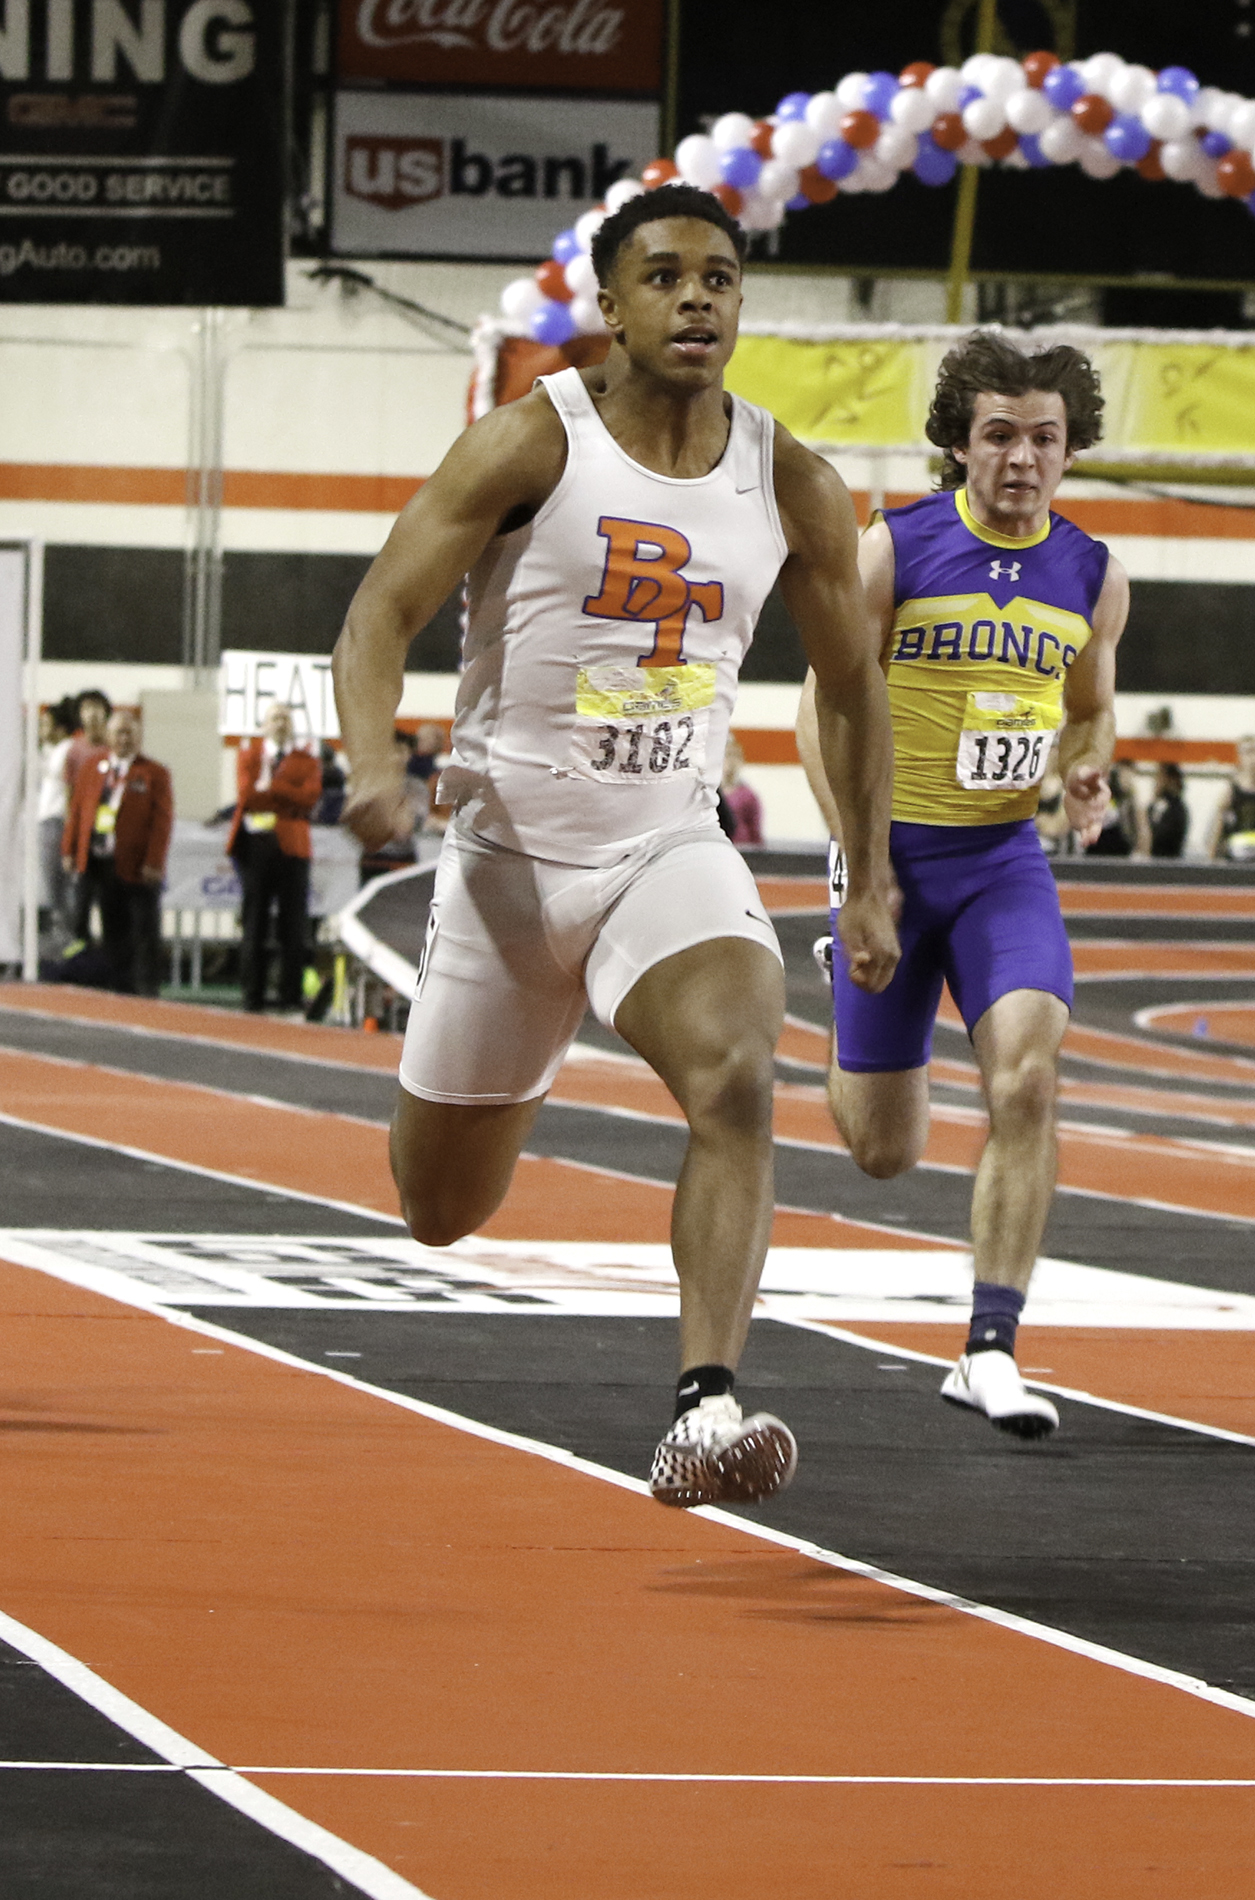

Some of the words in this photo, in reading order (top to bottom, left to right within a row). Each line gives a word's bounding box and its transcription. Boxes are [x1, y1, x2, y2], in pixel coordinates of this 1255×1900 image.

[6, 172, 98, 200] GOOD
[105, 174, 230, 200] SERVICE
[349, 147, 441, 195] us
[450, 137, 634, 200] bank
[223, 661, 333, 738] HEAT
[590, 716, 694, 774] 3182
[970, 735, 1044, 781] 1326
